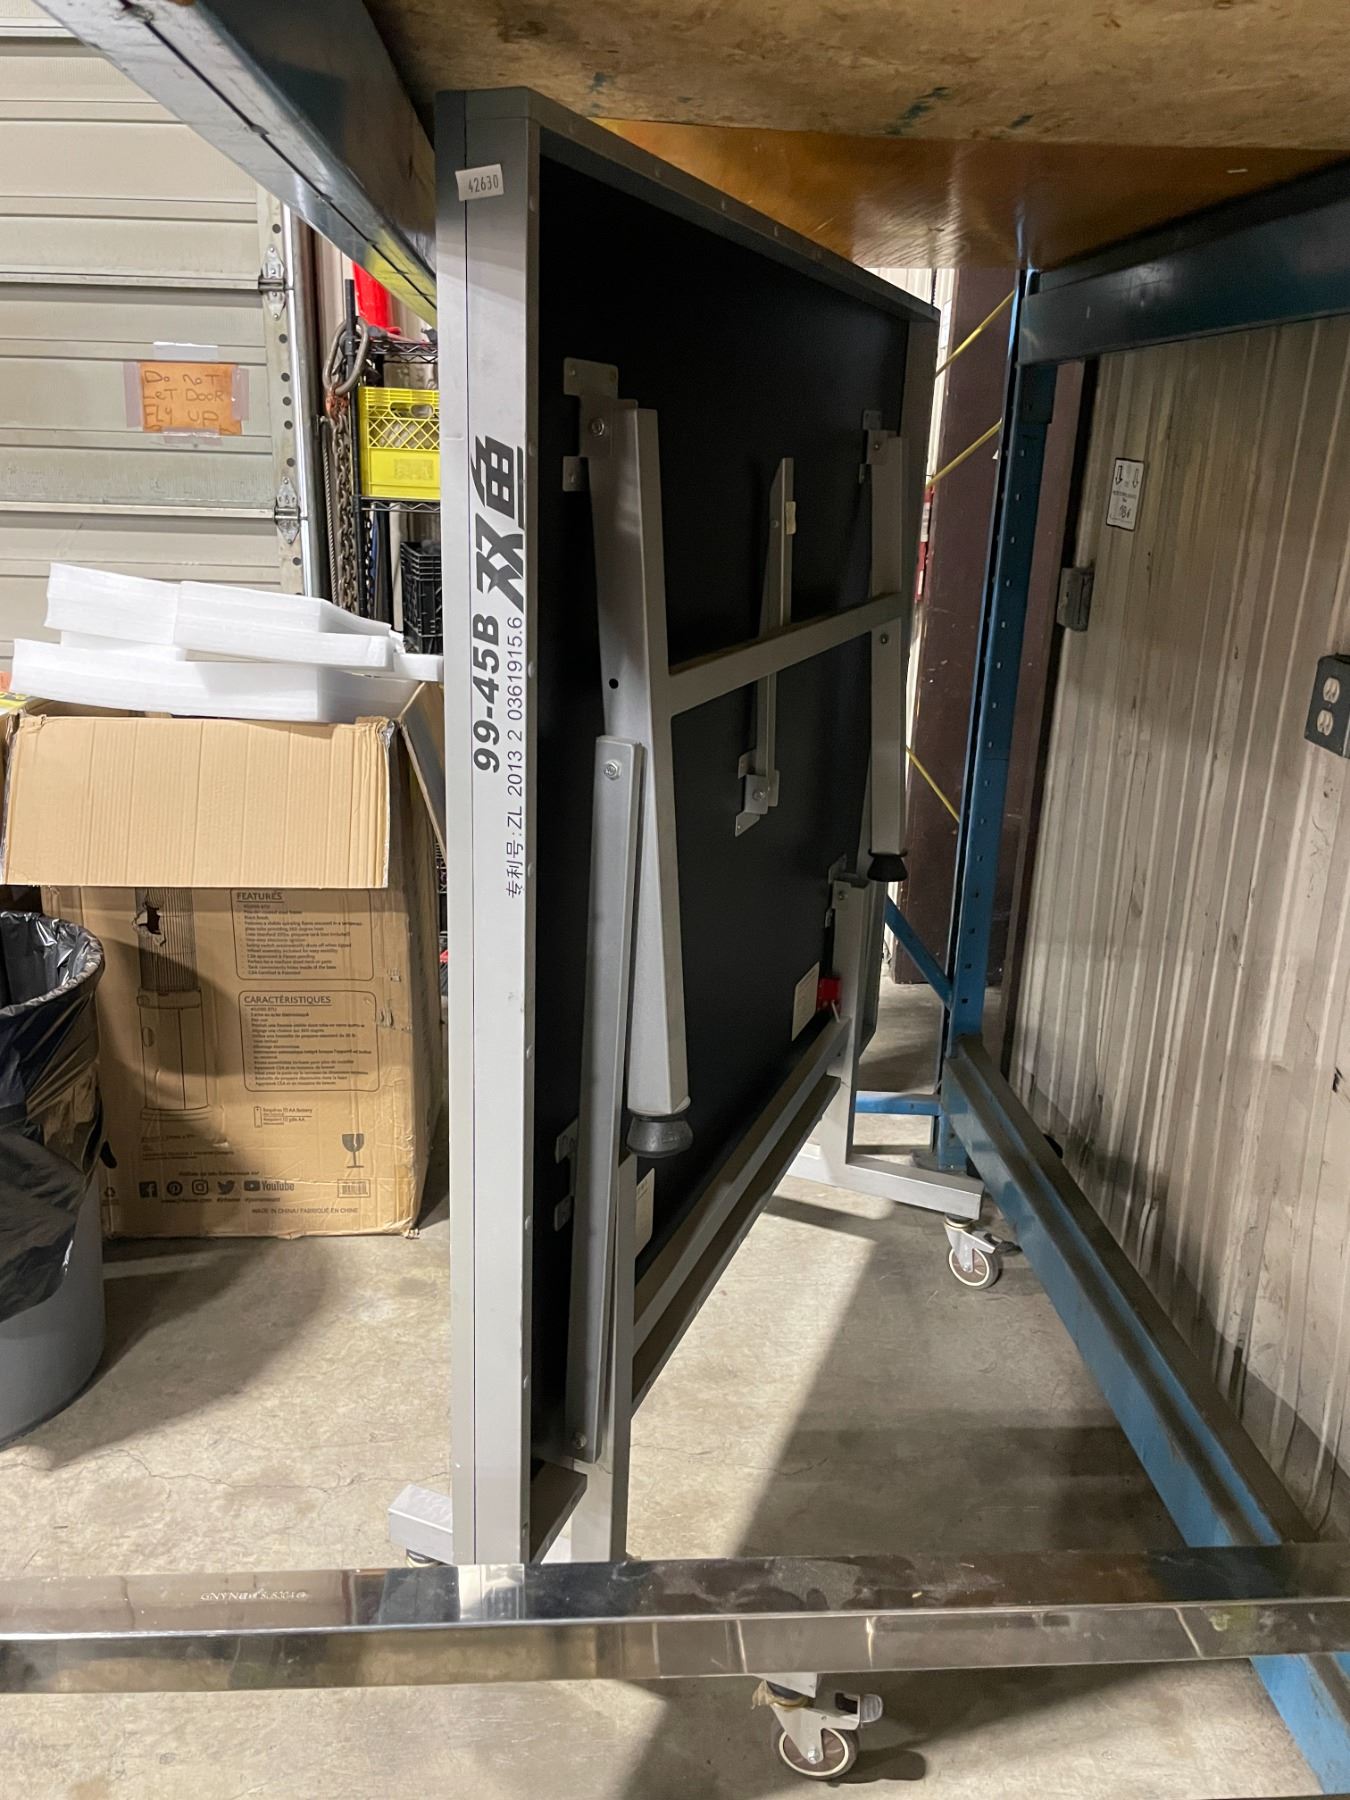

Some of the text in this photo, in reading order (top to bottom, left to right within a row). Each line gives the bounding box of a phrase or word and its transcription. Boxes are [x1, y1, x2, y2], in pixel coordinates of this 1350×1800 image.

[468, 174, 499, 193] 42630
[470, 435, 525, 614] 双鱼
[507, 616, 523, 721] 0361915.6
[472, 613, 500, 774] 99-45B
[507, 729, 523, 742] 2
[507, 750, 523, 797] 2013
[236, 891, 283, 901] FEATURES
[244, 995, 332, 1004] CARACTÉRISTIQUES
[261, 1180, 295, 1192] YouTube
